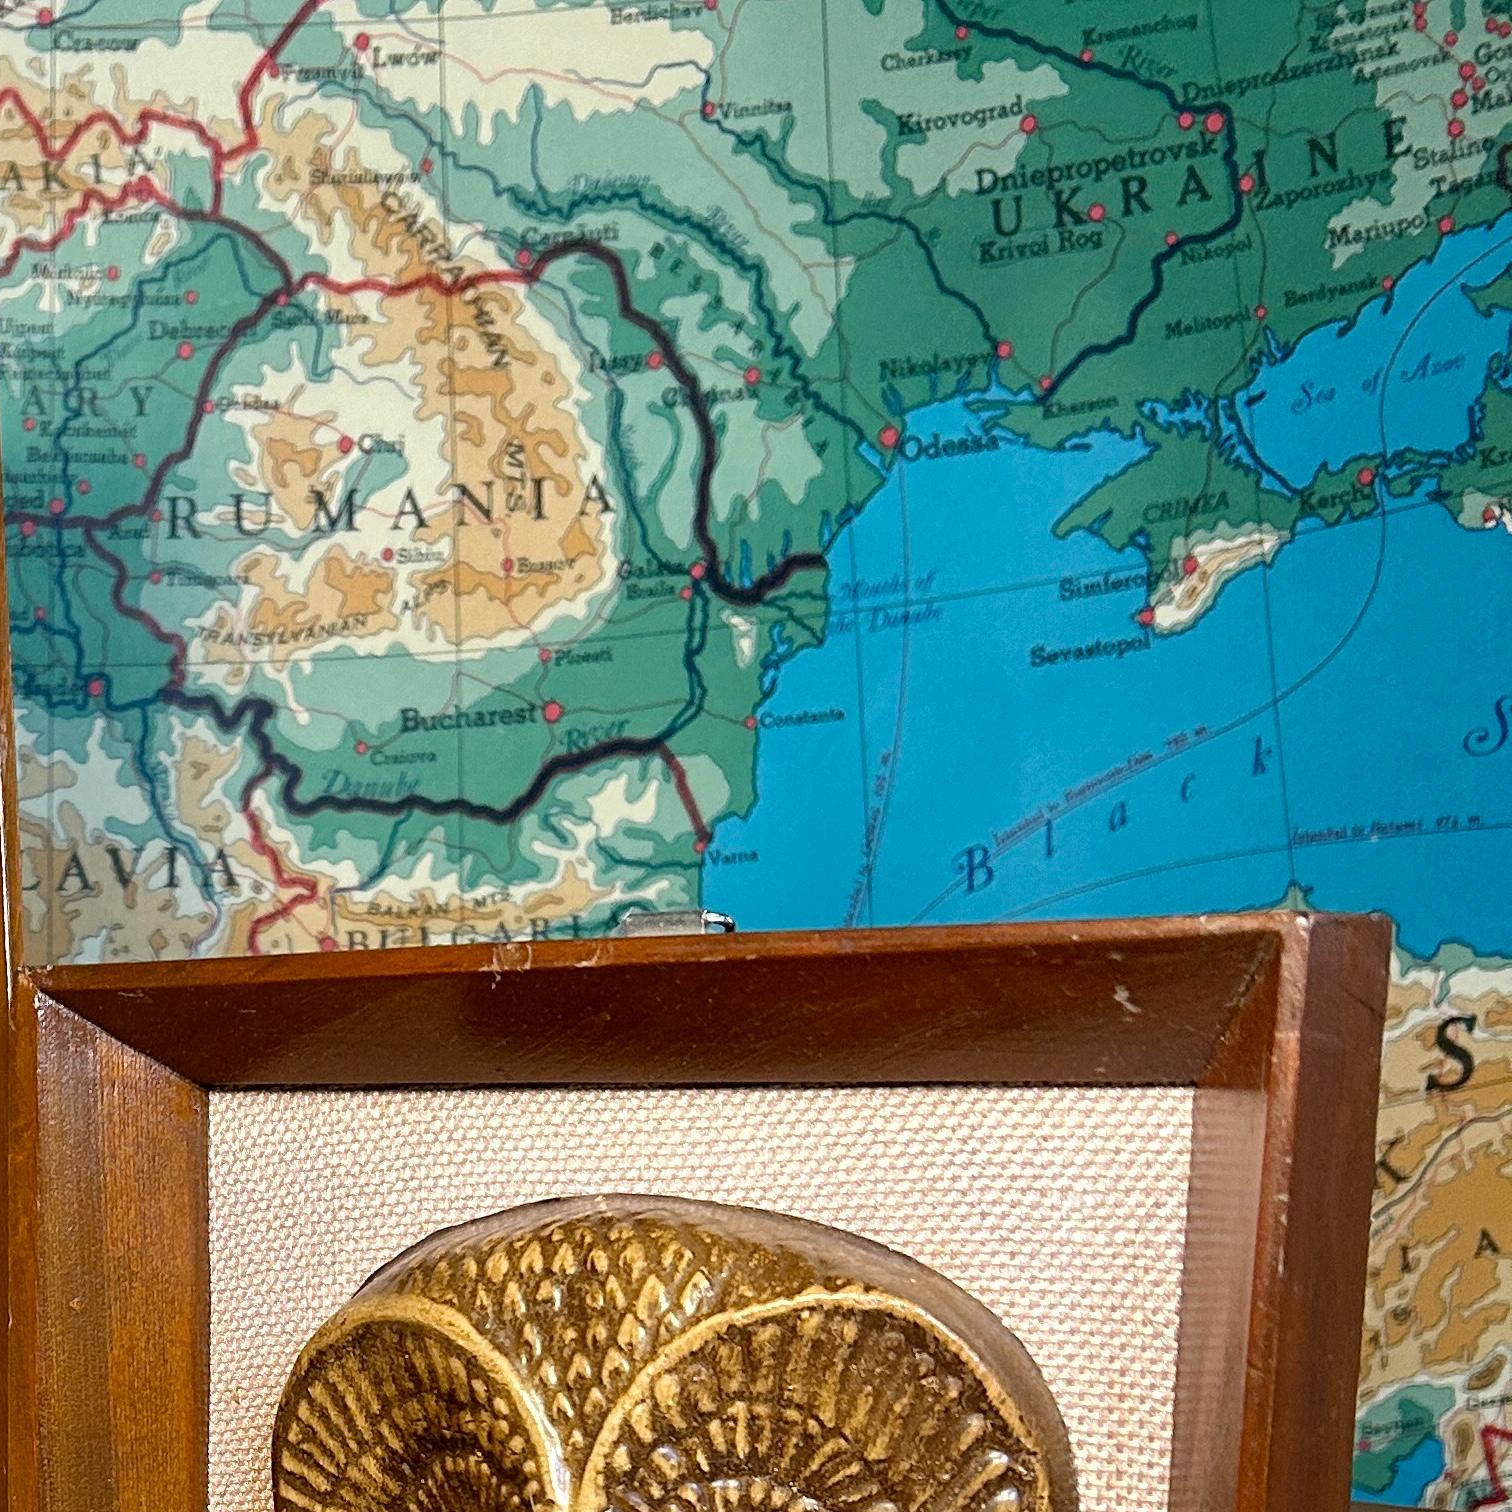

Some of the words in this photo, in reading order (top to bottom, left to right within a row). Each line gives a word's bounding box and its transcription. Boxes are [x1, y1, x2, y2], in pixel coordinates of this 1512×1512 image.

[1082, 13, 1199, 47] Kremenchug
[371, 43, 442, 68] Lwów
[895, 95, 1024, 136] Kirovograd
[975, 131, 1219, 196] Dniepropetrovsk
[1413, 135, 1494, 170] Stalino
[989, 116, 1412, 238] UKRAINE
[1254, 167, 1393, 212] Zaporozhye
[1328, 211, 1431, 248] Mariupol
[977, 241, 1051, 266] Krivoi
[1056, 228, 1105, 254] Rog
[1179, 231, 1254, 266] Nikopol
[1163, 305, 1251, 340] Melitopol
[878, 351, 995, 382] Nikolayev
[1289, 377, 1337, 416] Sea
[1361, 364, 1384, 397] of
[899, 431, 1000, 460] Odessa
[165, 473, 617, 543] RUMANIA
[1142, 490, 1230, 524] CRIMEA
[1298, 485, 1372, 517] Kerch
[196, 616, 368, 647] TRANSYLVANIAN
[1029, 635, 1151, 669] Sevastopol
[400, 702, 538, 734] Bucharest
[323, 768, 422, 798] Danube
[708, 849, 760, 867] Varna
